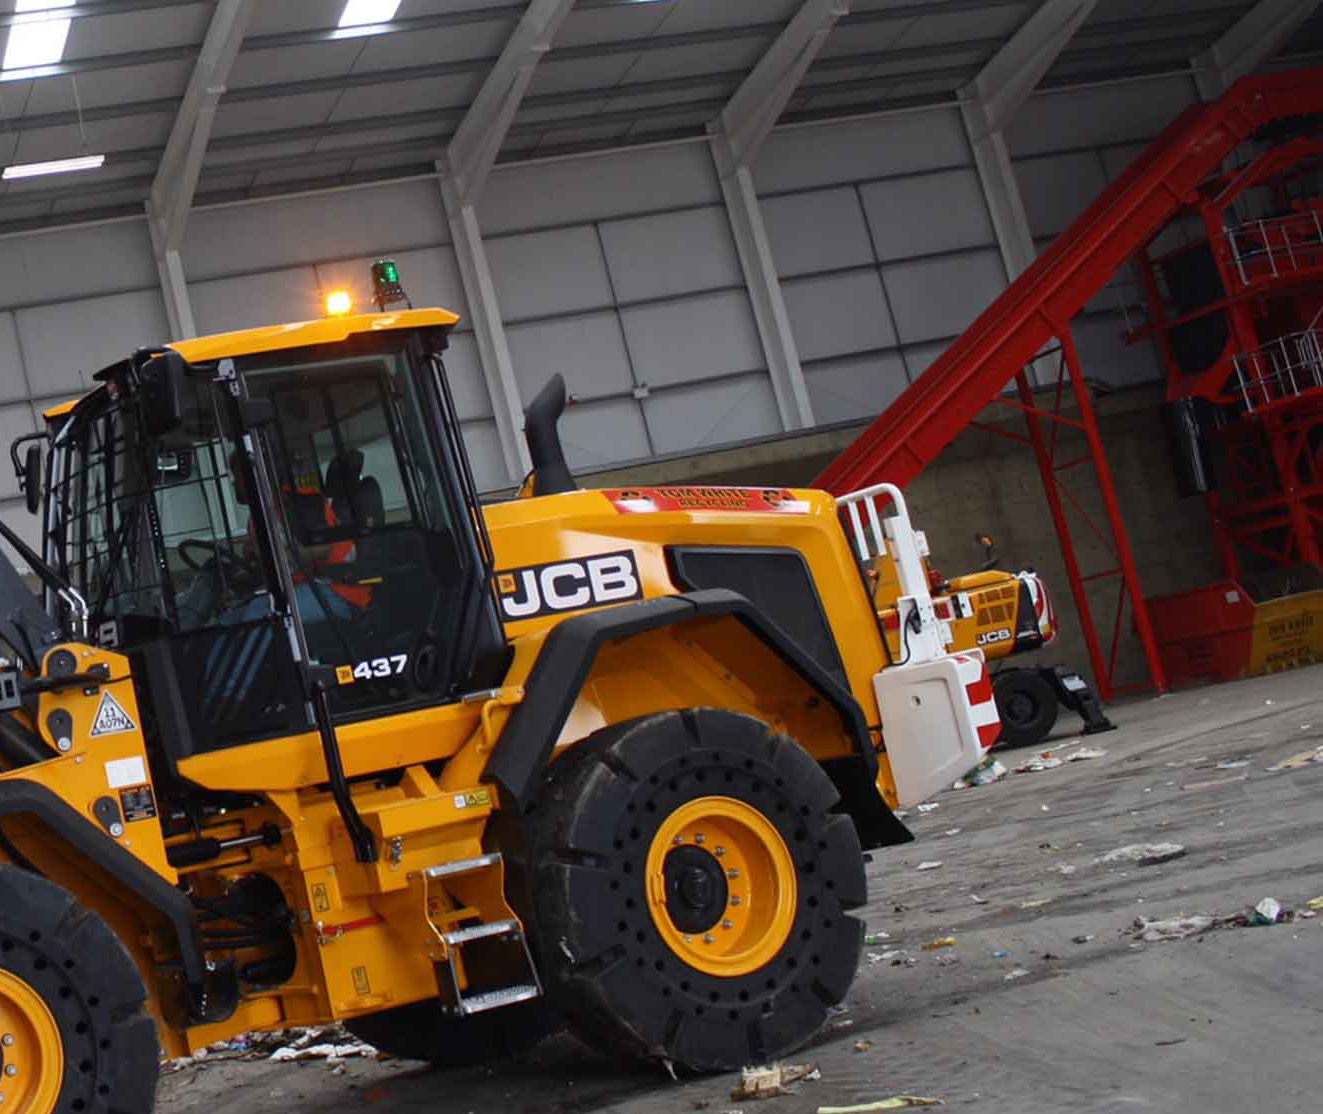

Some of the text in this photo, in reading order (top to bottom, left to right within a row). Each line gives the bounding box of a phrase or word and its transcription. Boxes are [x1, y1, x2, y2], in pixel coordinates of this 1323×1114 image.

[502, 555, 638, 617] JCB
[977, 628, 1011, 645] JCB
[353, 653, 408, 680] 437
